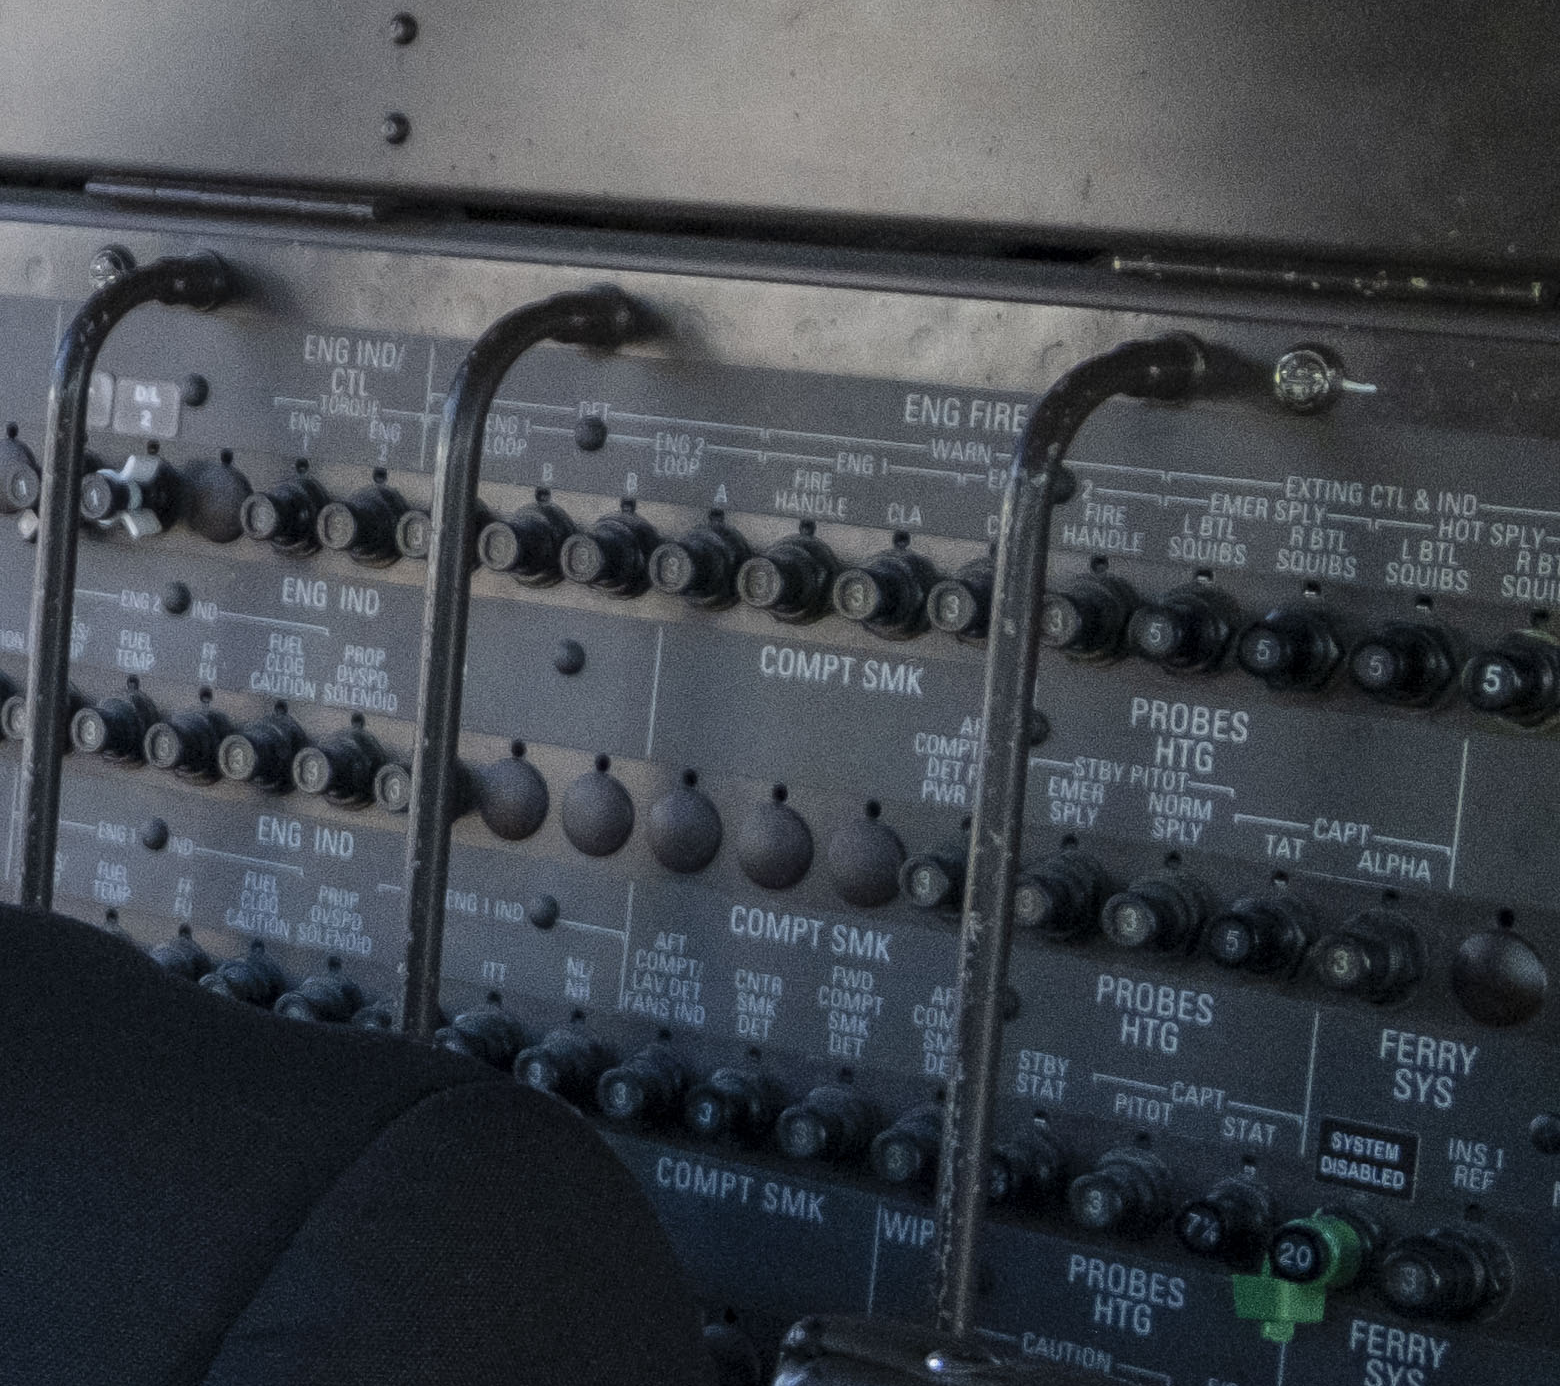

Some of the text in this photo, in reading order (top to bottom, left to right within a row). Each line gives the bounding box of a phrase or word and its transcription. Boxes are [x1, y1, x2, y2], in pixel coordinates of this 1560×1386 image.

[331, 369, 369, 396] CTL
[904, 393, 1029, 433] ENG FIRE
[931, 438, 992, 464] WARN
[793, 469, 832, 492] FIRE
[775, 492, 848, 517] HANDLE
[1209, 493, 1327, 525] EMER SPLY
[1284, 476, 1478, 517] EXTING CTL & IND
[1084, 502, 1127, 525] FIRE
[1063, 525, 1145, 553] HANDLE
[1438, 518, 1548, 549] HOT SPLY
[1168, 536, 1248, 566] SQUIBS
[1276, 549, 1358, 579] SQUIBS
[1385, 562, 1471, 593] SQUIBS
[282, 577, 380, 617] ENG IND
[759, 645, 924, 698] COMPT SMK
[1130, 697, 1250, 744] PROBES
[1155, 736, 1214, 774] HTG
[1048, 778, 1105, 805] EMER
[1149, 794, 1213, 820] NORM
[257, 815, 355, 860] ENG IND
[1152, 818, 1204, 844] SPLY
[1313, 818, 1371, 844] CAPT
[1265, 834, 1305, 860] TAT
[1358, 851, 1432, 881] ALPHA
[730, 905, 892, 962] COMPT SMK
[819, 985, 884, 1015] COMPT
[1096, 974, 1215, 1026] PROBES
[828, 1012, 870, 1037] SMK
[1120, 1014, 1179, 1055] HTG
[829, 1033, 864, 1059] DET
[1380, 1028, 1480, 1076] FERRY
[1019, 1049, 1069, 1075] STBY
[1017, 1073, 1066, 1101] STAT
[1171, 1082, 1226, 1107] CAPT
[1393, 1069, 1454, 1110] SYS
[1114, 1093, 1174, 1125] PITOT
[1223, 1117, 1277, 1146] STAT
[1330, 1131, 1401, 1163] SYSTEM
[1449, 1139, 1488, 1166] INS
[1320, 1155, 1406, 1190] DISABLED
[1453, 1165, 1495, 1192] REF
[656, 1156, 825, 1223] COMPT SMK
[1087, 1190, 1104, 1216] 3
[1278, 1243, 1312, 1268] 20
[1068, 1254, 1186, 1309] PROBES
[1401, 1265, 1417, 1293] 3
[1094, 1299, 1152, 1335] HTG
[1350, 1320, 1450, 1371] FERRY
